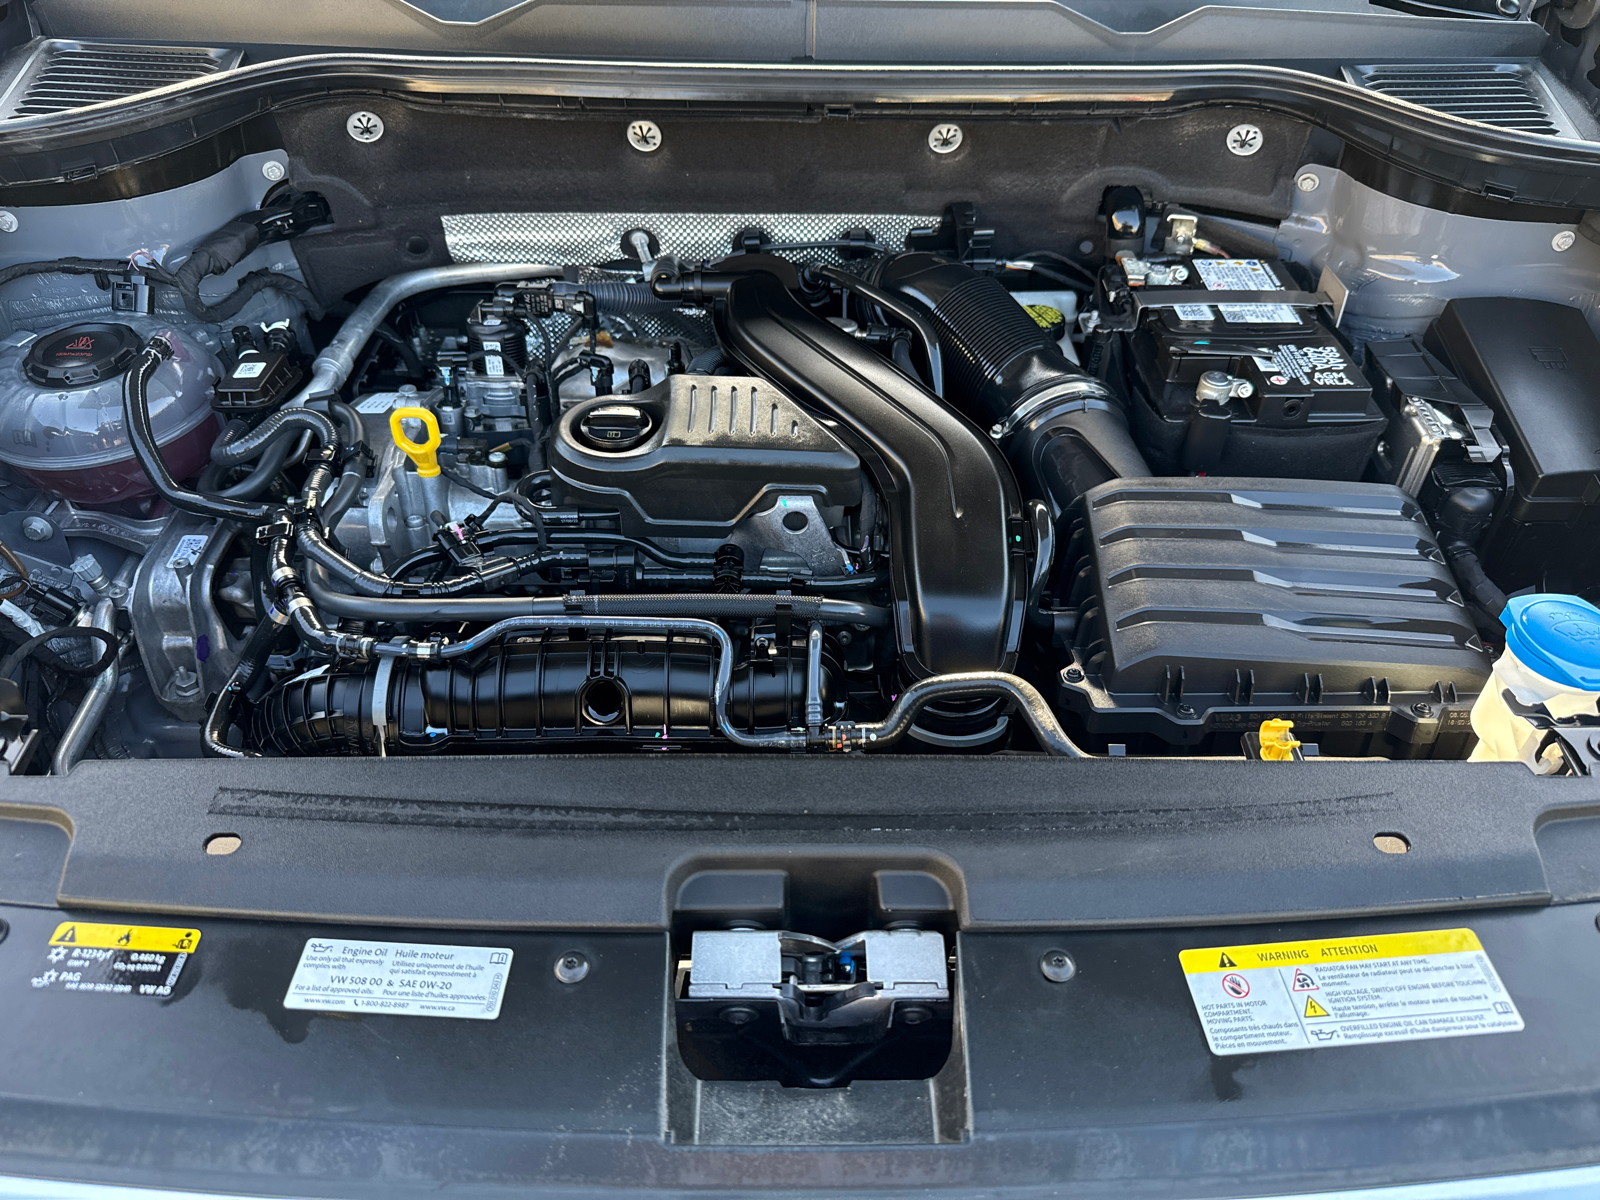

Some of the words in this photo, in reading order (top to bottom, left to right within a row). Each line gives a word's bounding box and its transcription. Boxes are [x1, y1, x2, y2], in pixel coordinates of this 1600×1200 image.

[1318, 346, 1348, 370] 58Ah
[1313, 378, 1355, 386] VRLA
[342, 946, 373, 957] Engine
[374, 948, 388, 957] Oil
[394, 949, 419, 959] Huile
[420, 951, 455, 960] moteur
[1256, 949, 1310, 962] WARNING
[1320, 943, 1379, 957] ATTENTION
[154, 954, 167, 965] kg
[318, 955, 333, 963] only
[341, 956, 355, 964] that
[355, 957, 385, 966] expressly
[391, 960, 416, 968] Utilisez
[415, 961, 455, 970] uniquement
[464, 963, 485, 971] l'huile
[1314, 964, 1346, 973] RADIATOR
[1359, 962, 1372, 970] MAY
[58, 971, 82, 982] PAG
[400, 968, 426, 976] satisfait
[426, 970, 471, 979] expressément
[1327, 972, 1361, 981] ventilateur
[1370, 969, 1399, 977] radiateur
[1399, 968, 1414, 976] peut
[1422, 964, 1455, 973] déclencher
[330, 975, 348, 984] VW
[349, 976, 368, 985] 508
[369, 977, 383, 986] 00
[386, 979, 394, 987] &
[398, 979, 418, 988] SAE
[419, 979, 453, 990] 0W-20
[1340, 988, 1370, 996] VOLTAGE,
[1370, 986, 1395, 994] SWITCH
[1407, 983, 1431, 991] ENGINE
[1431, 981, 1456, 989] BEFORE
[1456, 978, 1488, 987] TOUCHING
[139, 984, 155, 995] VW
[155, 985, 172, 996] AG
[294, 983, 306, 991] For
[311, 984, 322, 992] list
[322, 984, 330, 992] of
[329, 986, 360, 995] approved
[360, 987, 374, 995] oils:
[382, 988, 397, 996] Pour
[411, 989, 424, 998] liste
[424, 990, 449, 999] d'huiles
[449, 992, 487, 1001] approuvées:
[1328, 995, 1357, 1004] IGNITION
[1356, 994, 1383, 1002] SYSTEM.
[361, 1000, 410, 1009] 1-800-822-8987
[419, 1004, 456, 1012] www.vw.ca
[1201, 1003, 1215, 1011] HOT
[1215, 1002, 1235, 1010] PARTS
[1244, 1000, 1268, 1008] MOTOR
[1351, 1003, 1379, 1011] tension,
[1379, 1001, 1400, 1009] arrêter
[1203, 1009, 1254, 1018] COMPARTMENT.
[1333, 1011, 1370, 1019] l'allumage.
[1206, 1016, 1233, 1025] MOVING
[1232, 1015, 1255, 1023] PARTS.
[1340, 1023, 1379, 1032] OVERFILLED
[1379, 1021, 1403, 1030] ENGINE
[1428, 1017, 1454, 1025] DAMAGE
[1209, 1024, 1248, 1035] Composants
[1249, 1023, 1261, 1031] très
[1261, 1022, 1283, 1030] chauds
[1343, 1030, 1383, 1039] Remplissage
[1409, 1027, 1431, 1035] d'huile
[1431, 1024, 1464, 1033] dangereux
[1212, 1034, 1220, 1042] le
[1219, 1031, 1266, 1042] compartiment
[1214, 1041, 1237, 1050] Pièces
[1246, 1038, 1288, 1047] mouvement.
